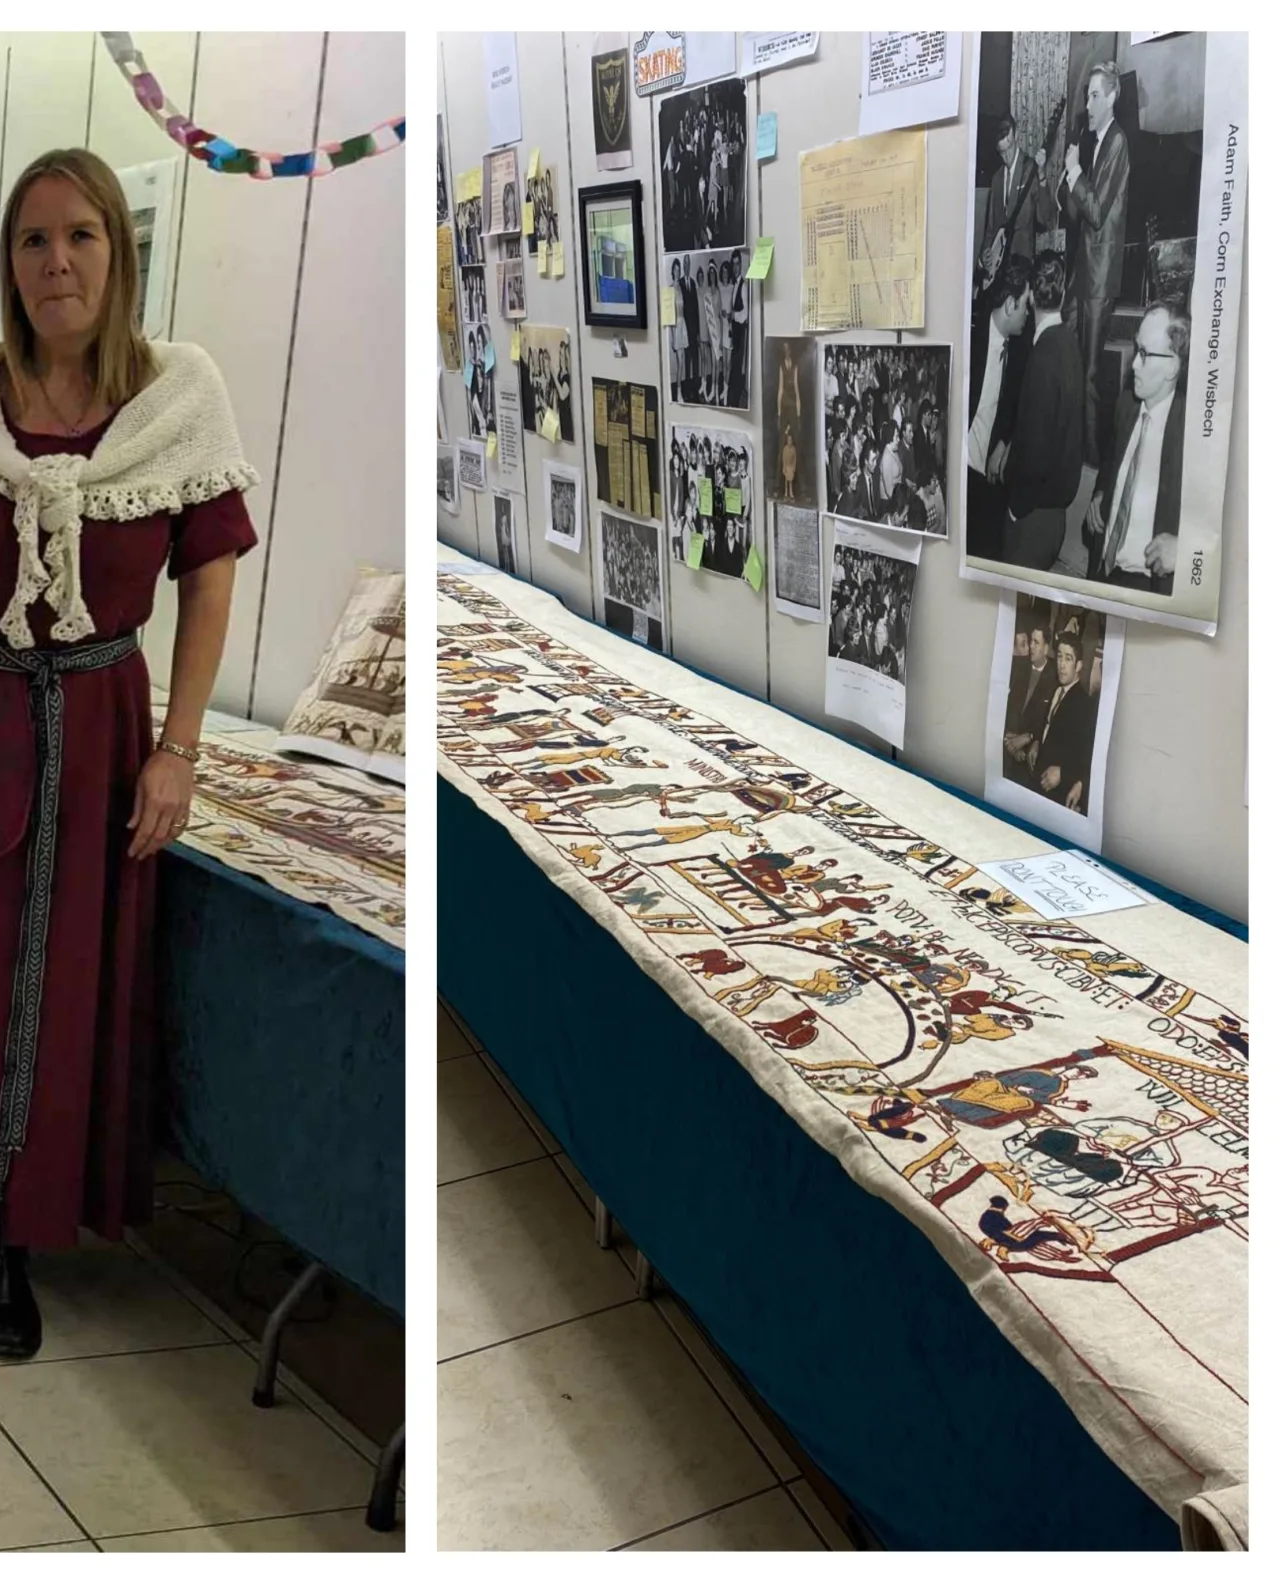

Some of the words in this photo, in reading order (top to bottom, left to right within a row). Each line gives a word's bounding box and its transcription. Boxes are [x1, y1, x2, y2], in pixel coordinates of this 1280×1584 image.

[638, 46, 684, 84] SKATING
[1225, 123, 1240, 176] Adam
[1218, 178, 1236, 227] Faith,
[1216, 230, 1231, 274] Corn
[1207, 276, 1227, 364] Exchange,
[1202, 368, 1220, 438] Wisbech
[1190, 549, 1204, 586] 1962
[1044, 860, 1108, 902] PLEASE
